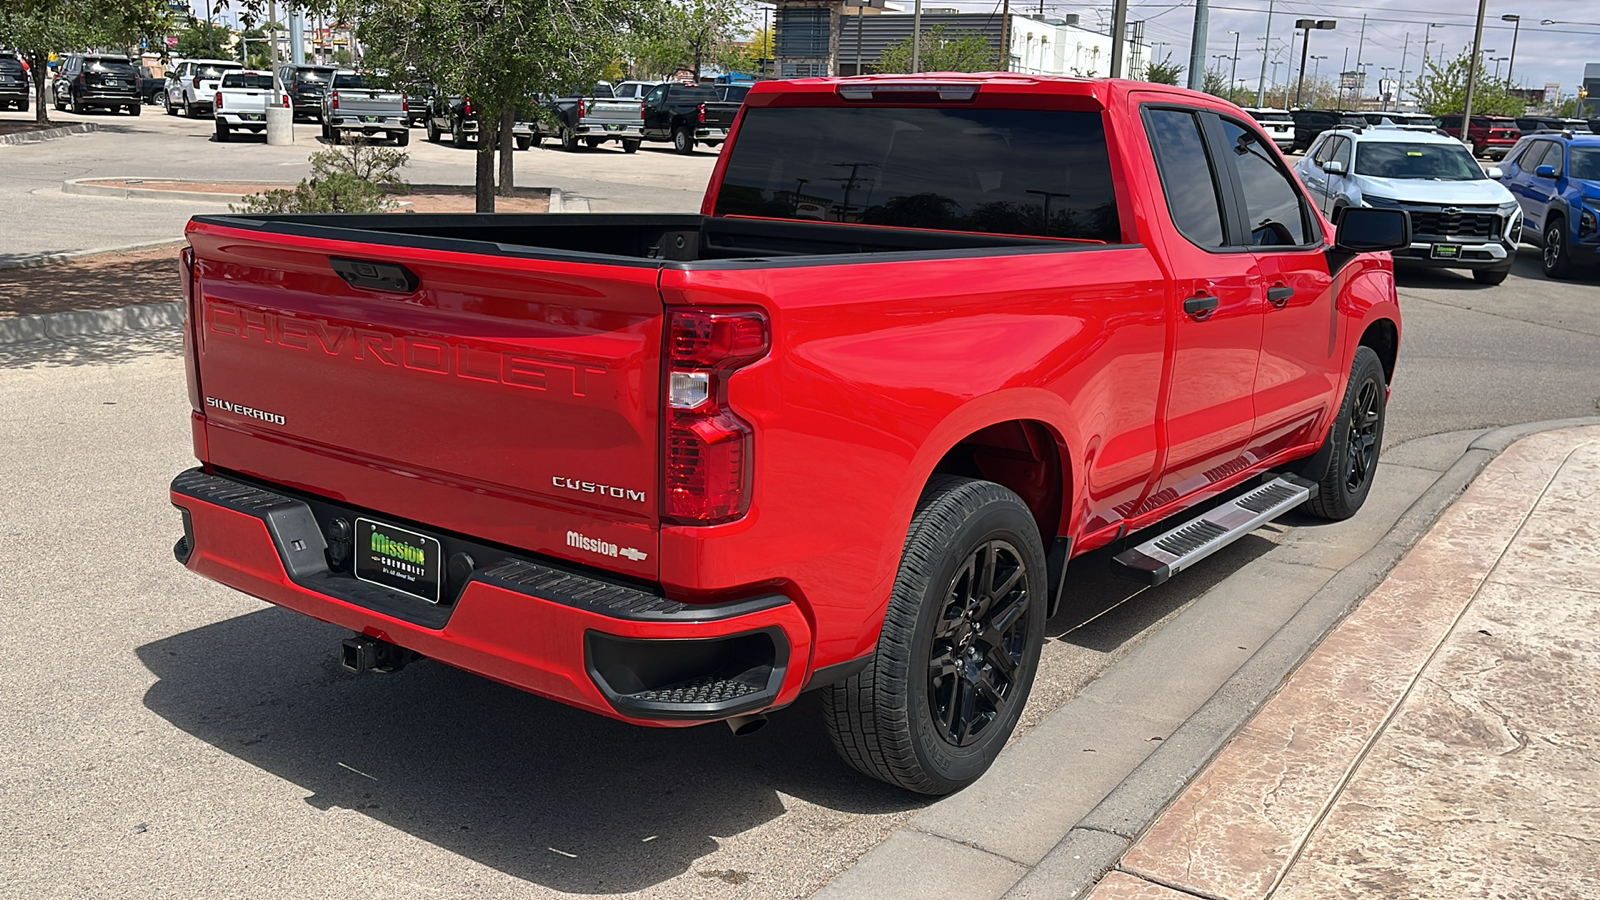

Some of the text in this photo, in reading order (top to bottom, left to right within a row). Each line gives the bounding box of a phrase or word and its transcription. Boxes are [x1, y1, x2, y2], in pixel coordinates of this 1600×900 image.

[208, 302, 609, 397] CHEVROLET
[206, 396, 286, 425] SILVERADO
[552, 476, 646, 502] CUSTOM
[371, 532, 425, 566] Mission
[566, 530, 618, 557] Mission
[381, 556, 425, 576] CHEVROLET
